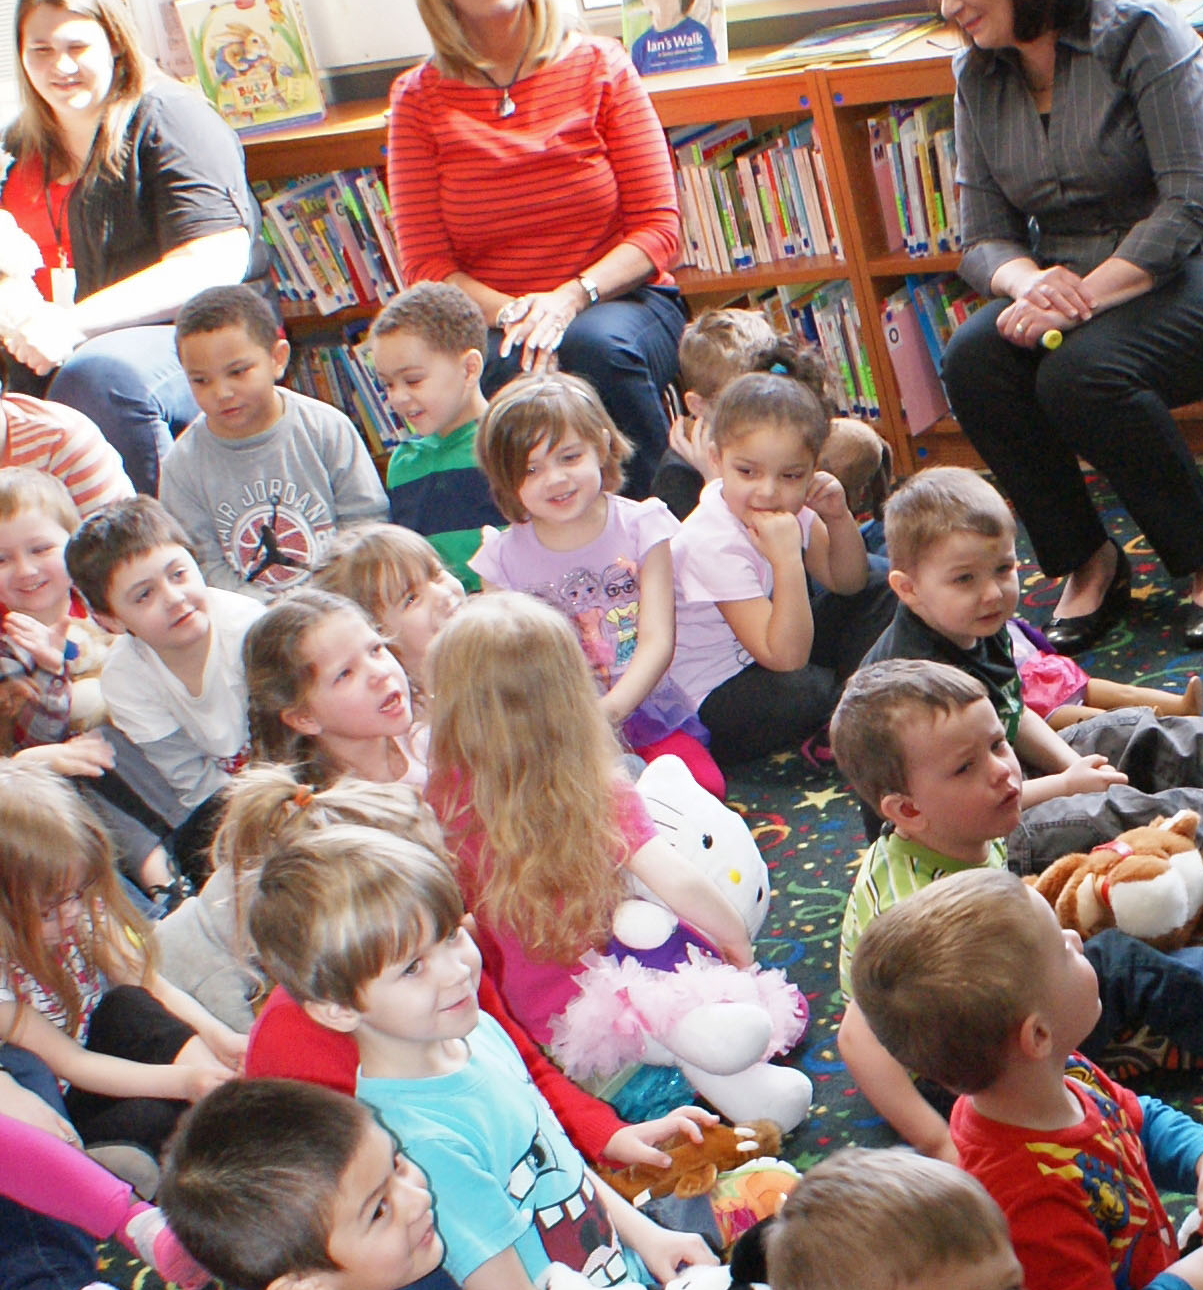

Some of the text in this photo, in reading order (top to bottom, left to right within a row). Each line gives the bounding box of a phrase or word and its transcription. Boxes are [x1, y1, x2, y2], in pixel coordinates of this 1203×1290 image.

[646, 36, 673, 53] Ian's
[672, 30, 704, 48] Walk
[238, 82, 267, 97] BUSY
[243, 92, 265, 106] DAY
[241, 478, 333, 527] JORDAN
